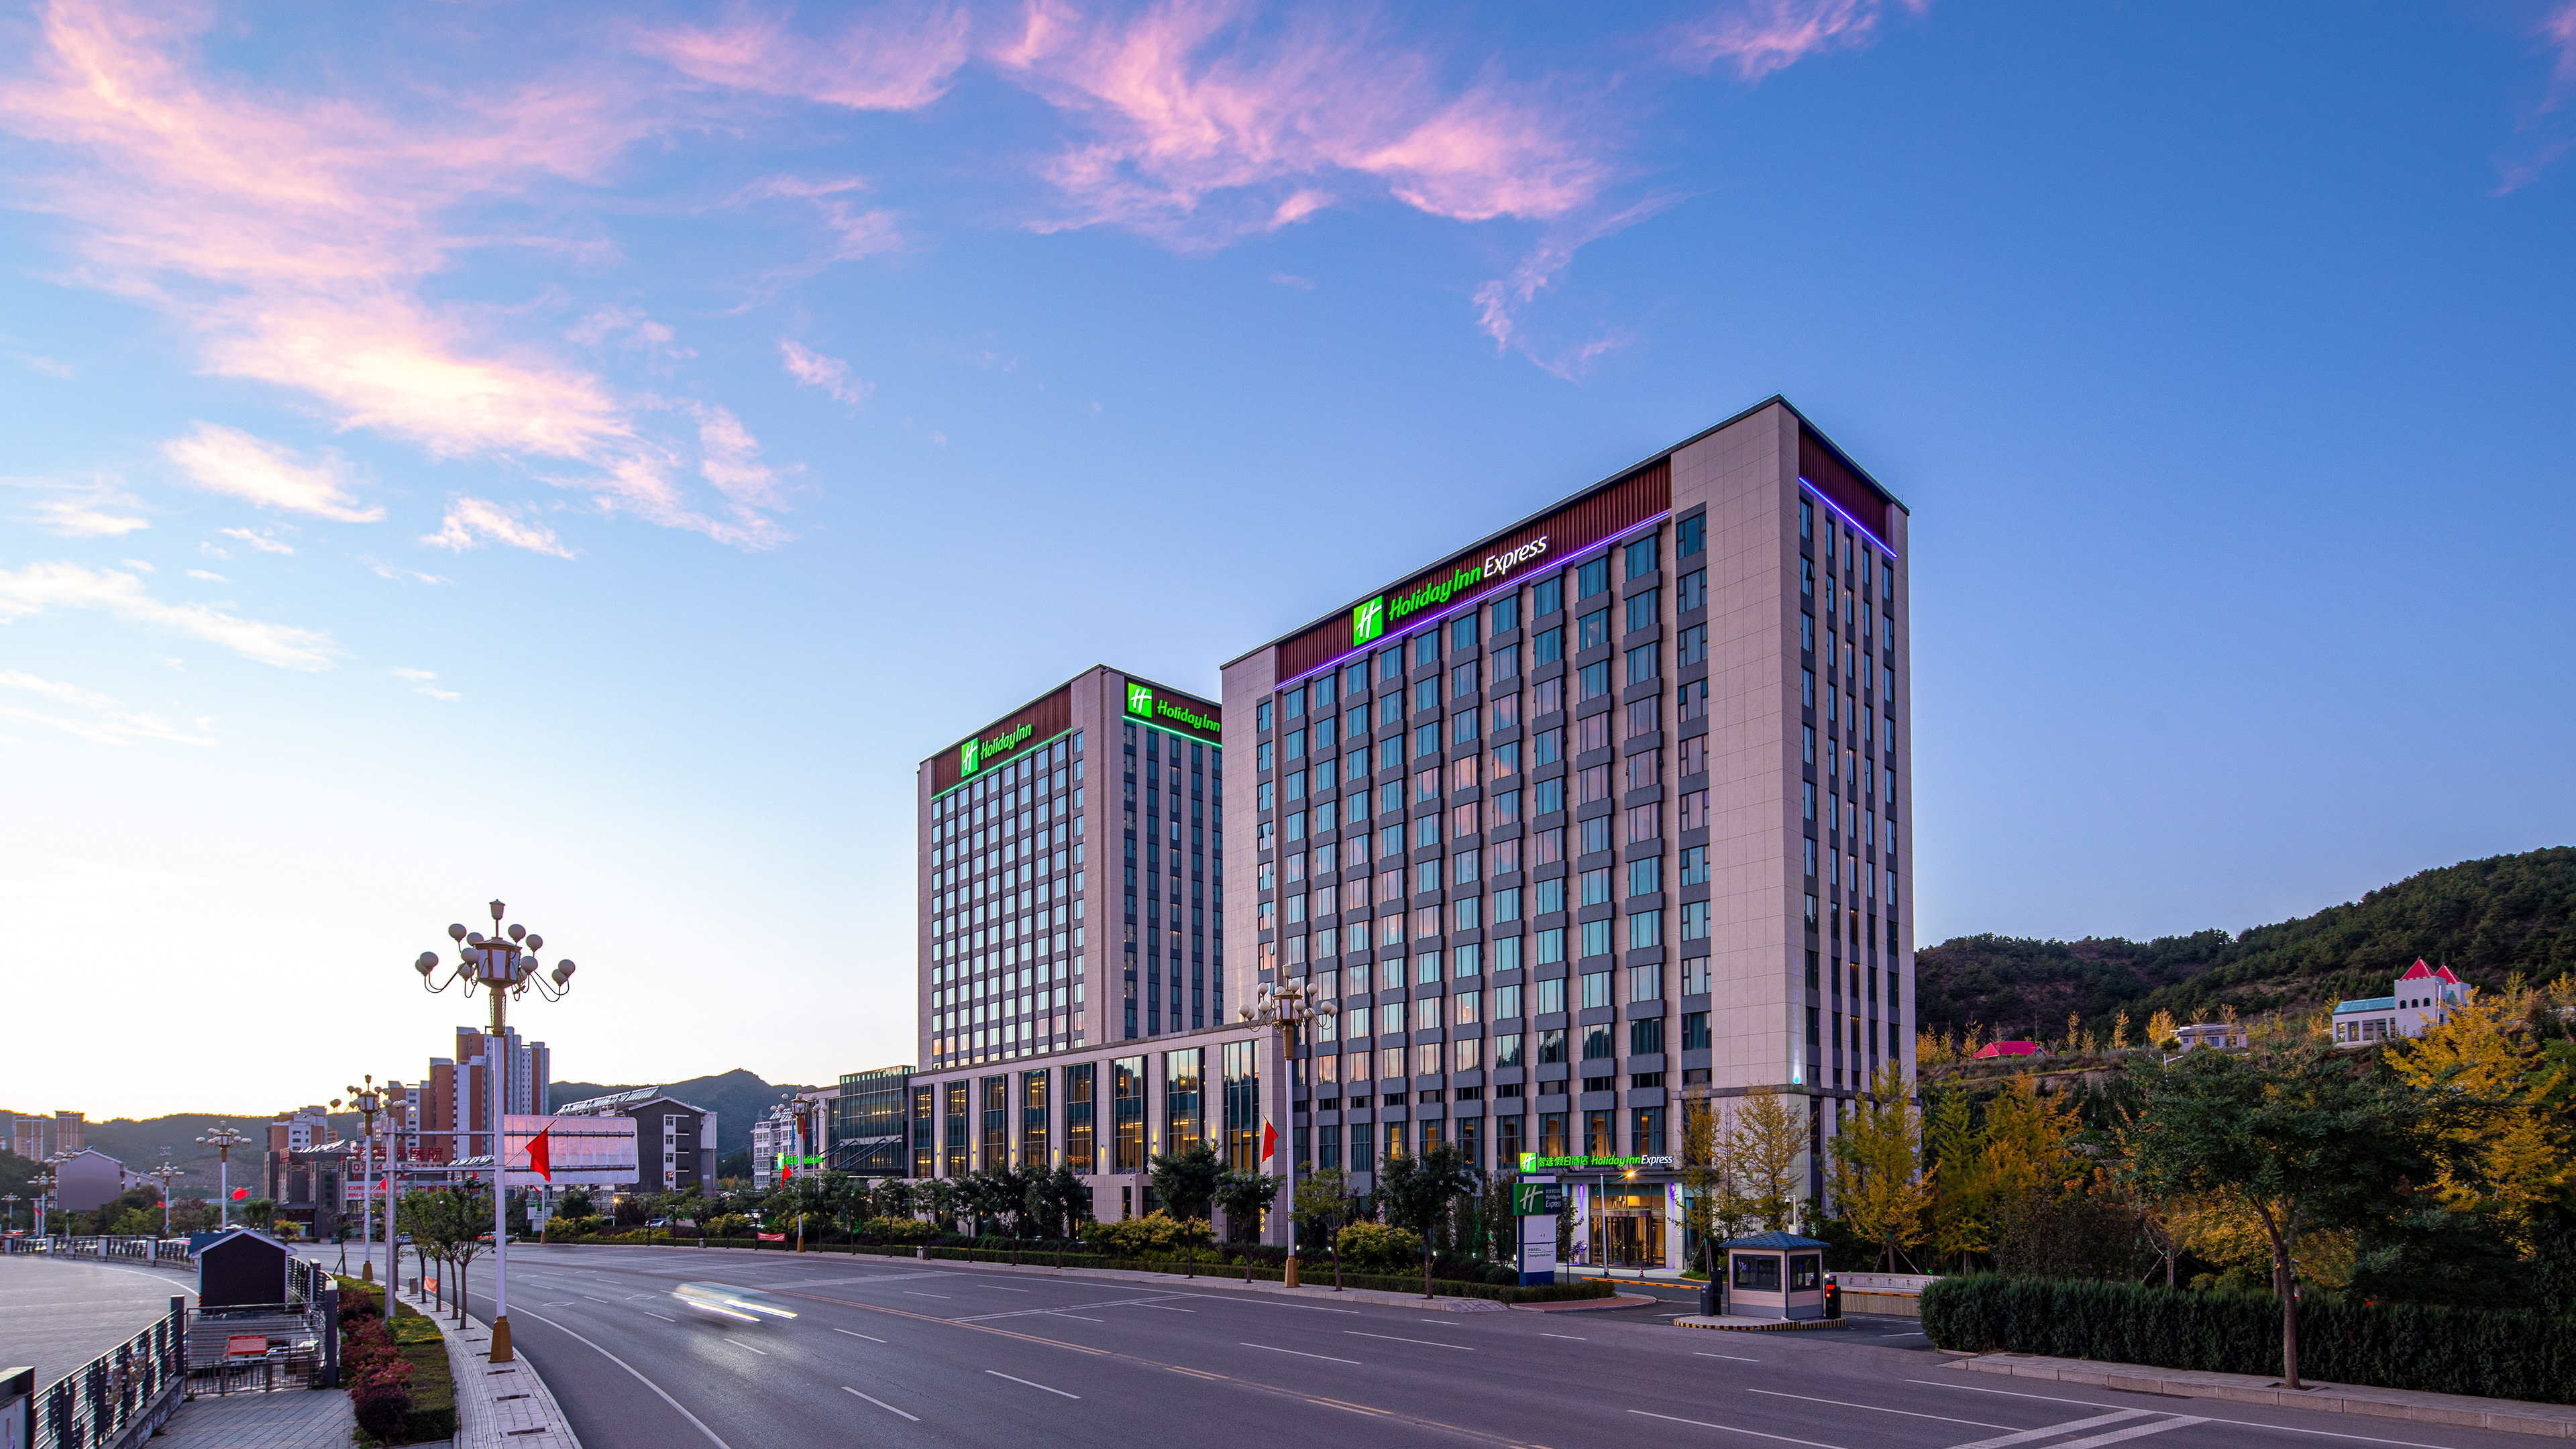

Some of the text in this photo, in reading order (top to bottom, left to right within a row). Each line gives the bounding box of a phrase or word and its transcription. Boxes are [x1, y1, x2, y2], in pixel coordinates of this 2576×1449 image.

[1484, 535, 1548, 578] Express
[1538, 1155, 1589, 1167] 智选假日酒店
[1641, 1155, 1673, 1167] Express
[1546, 1200, 1562, 1210] Express
